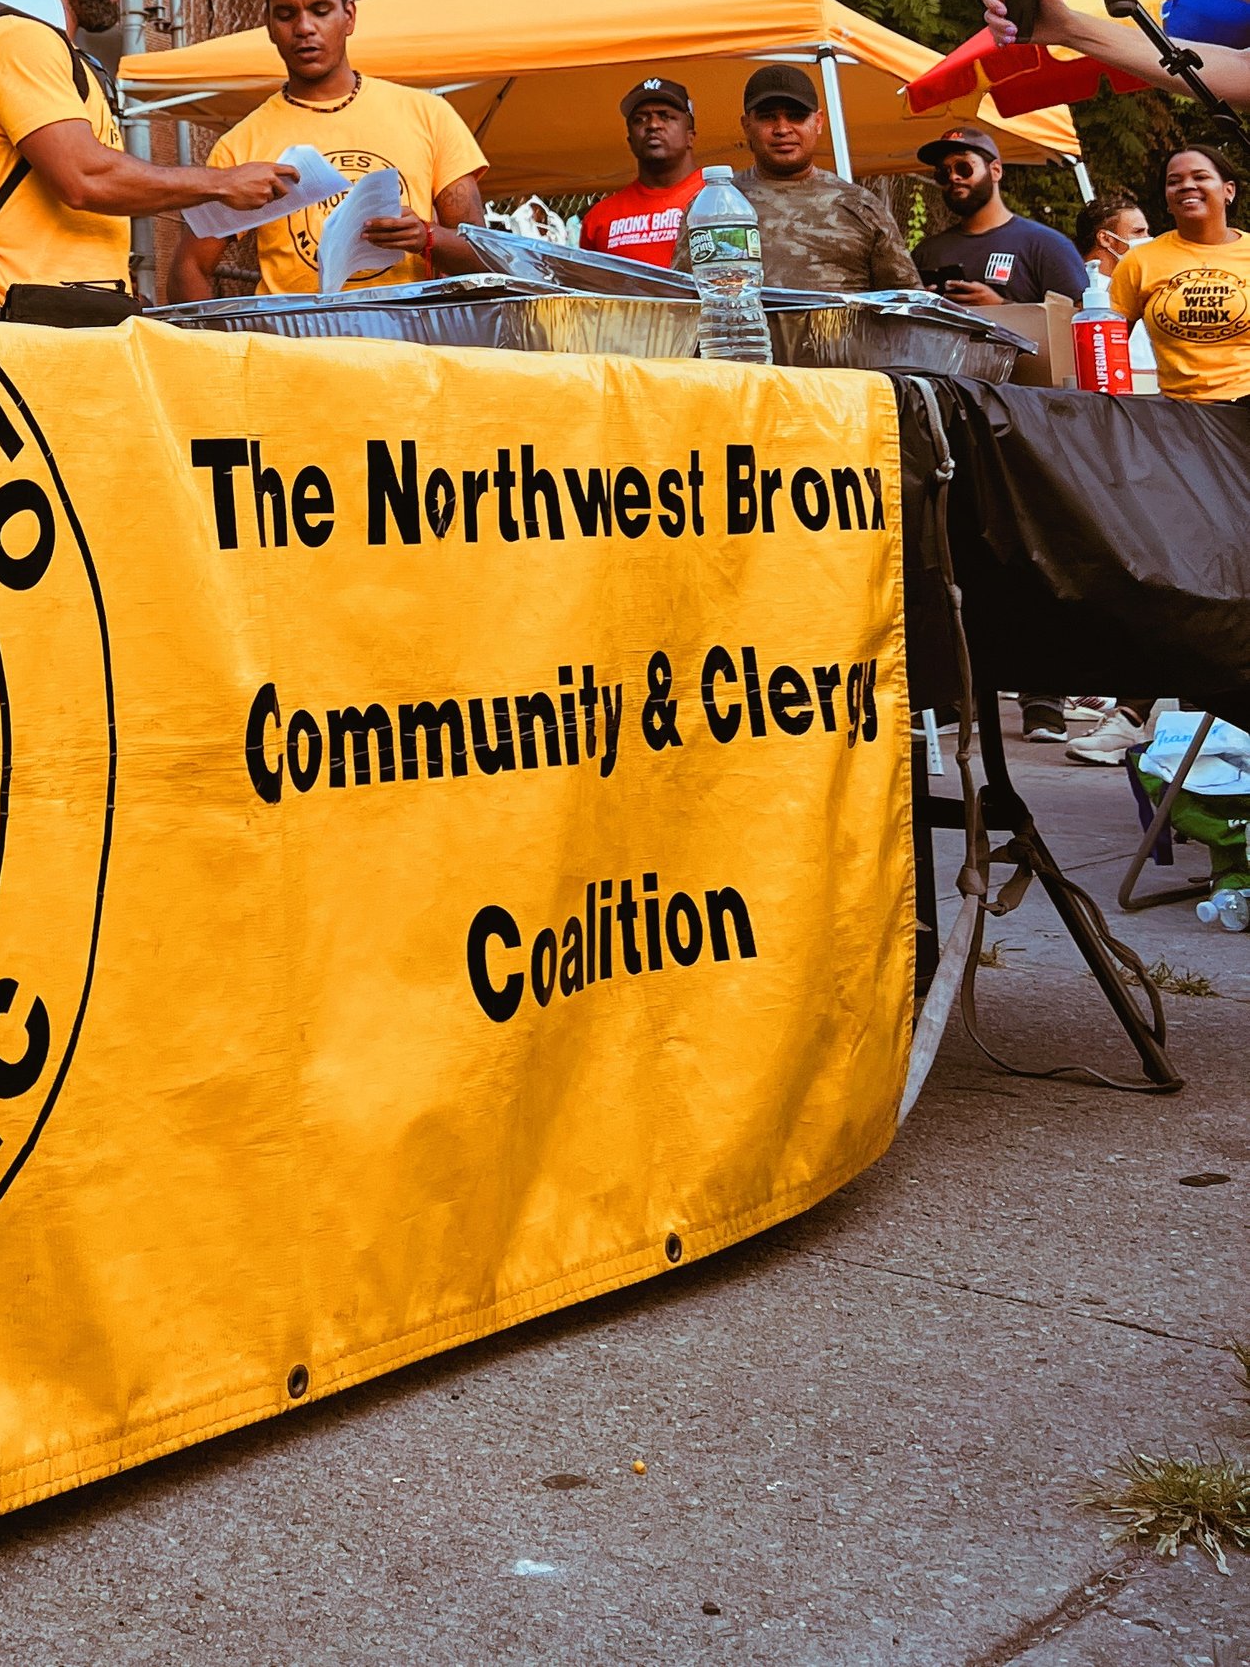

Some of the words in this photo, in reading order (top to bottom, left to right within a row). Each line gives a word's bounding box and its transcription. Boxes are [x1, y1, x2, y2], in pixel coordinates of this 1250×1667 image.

[609, 214, 650, 237] BRONX
[1182, 286, 1229, 296] NORTH
[1184, 296, 1224, 307] WEST
[1178, 310, 1230, 323] BRONX
[1093, 333, 1109, 386] LIFEGUARD
[191, 438, 335, 550] The
[367, 439, 704, 545] Northwest
[727, 444, 886, 535] Bronx
[245, 665, 623, 804] Community
[642, 650, 683, 750] &
[702, 646, 878, 749] Clergy
[467, 871, 758, 1023] Coalition
